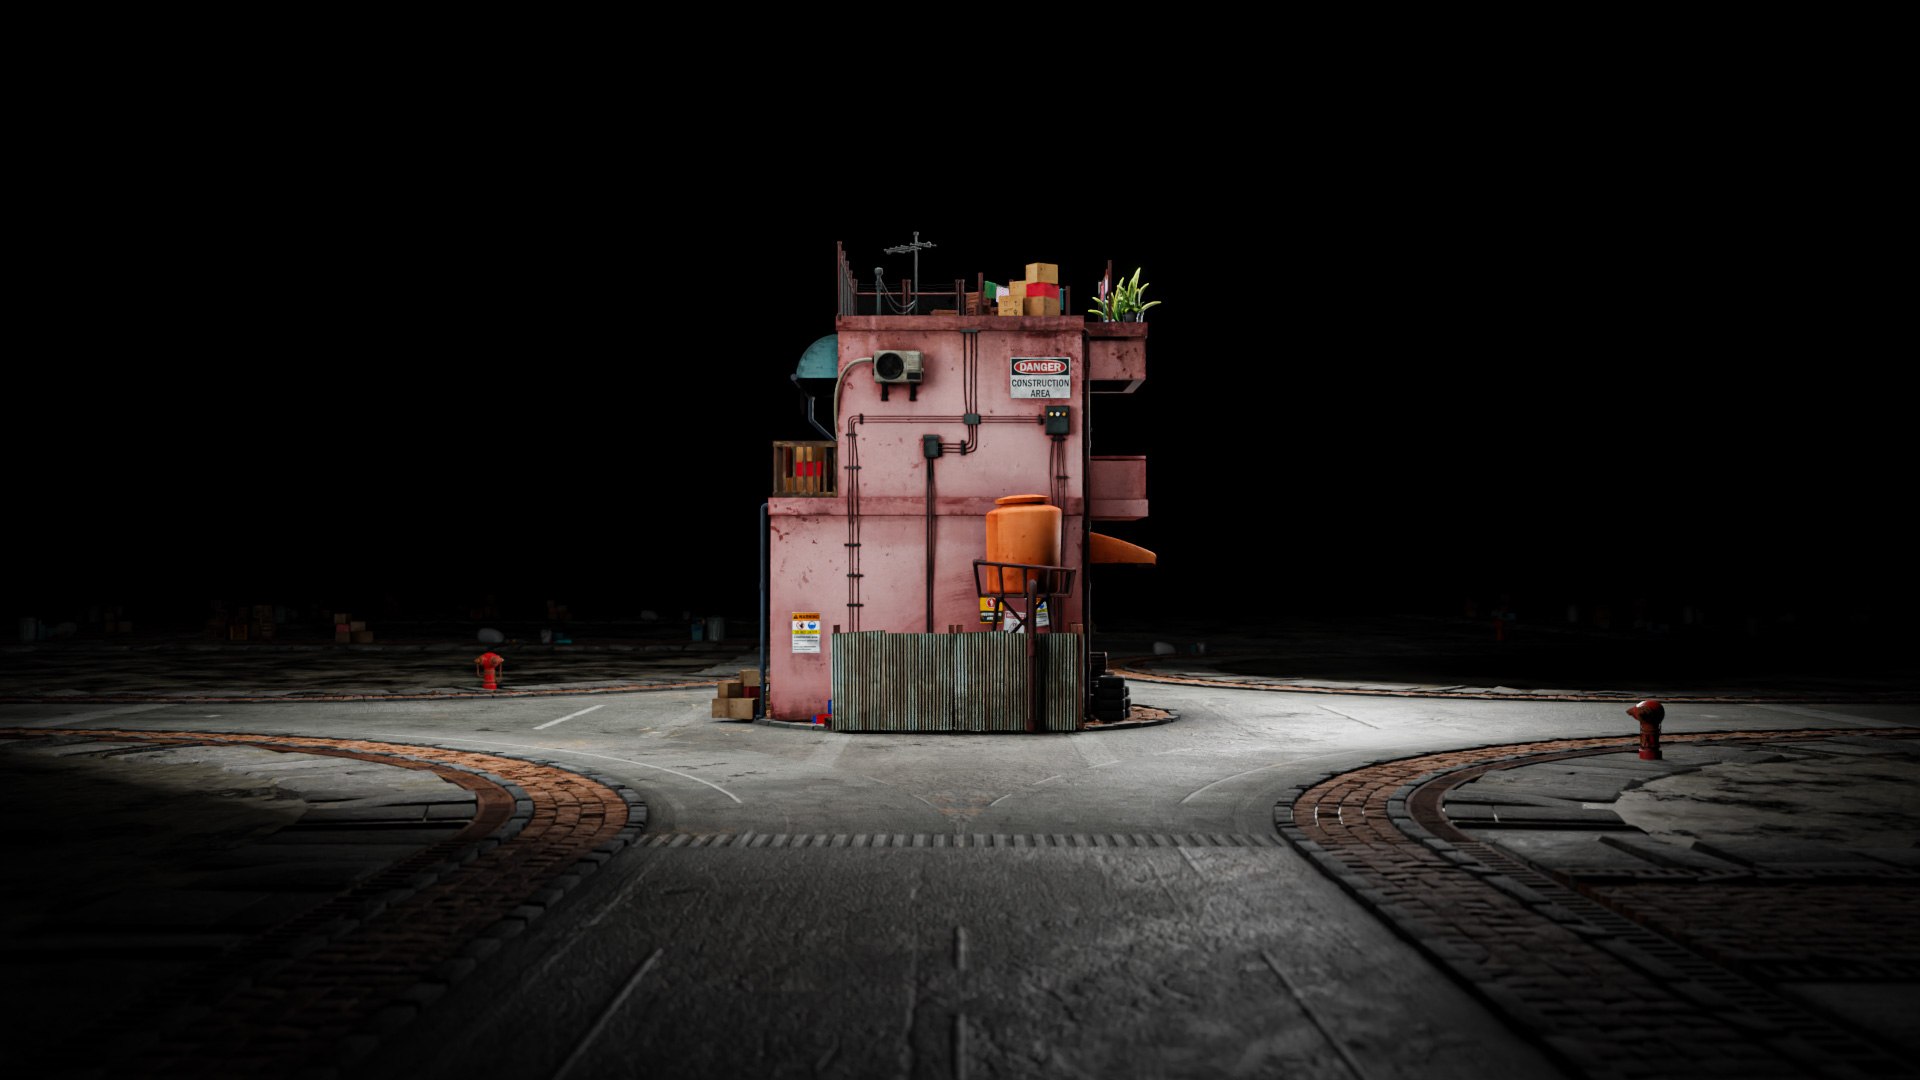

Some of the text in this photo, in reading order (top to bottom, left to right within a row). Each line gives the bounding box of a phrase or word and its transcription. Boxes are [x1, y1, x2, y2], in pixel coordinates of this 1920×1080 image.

[1019, 363, 1061, 372] DANGER
[1011, 379, 1069, 387] CONSTRUCTION
[1030, 389, 1051, 397] AREA
